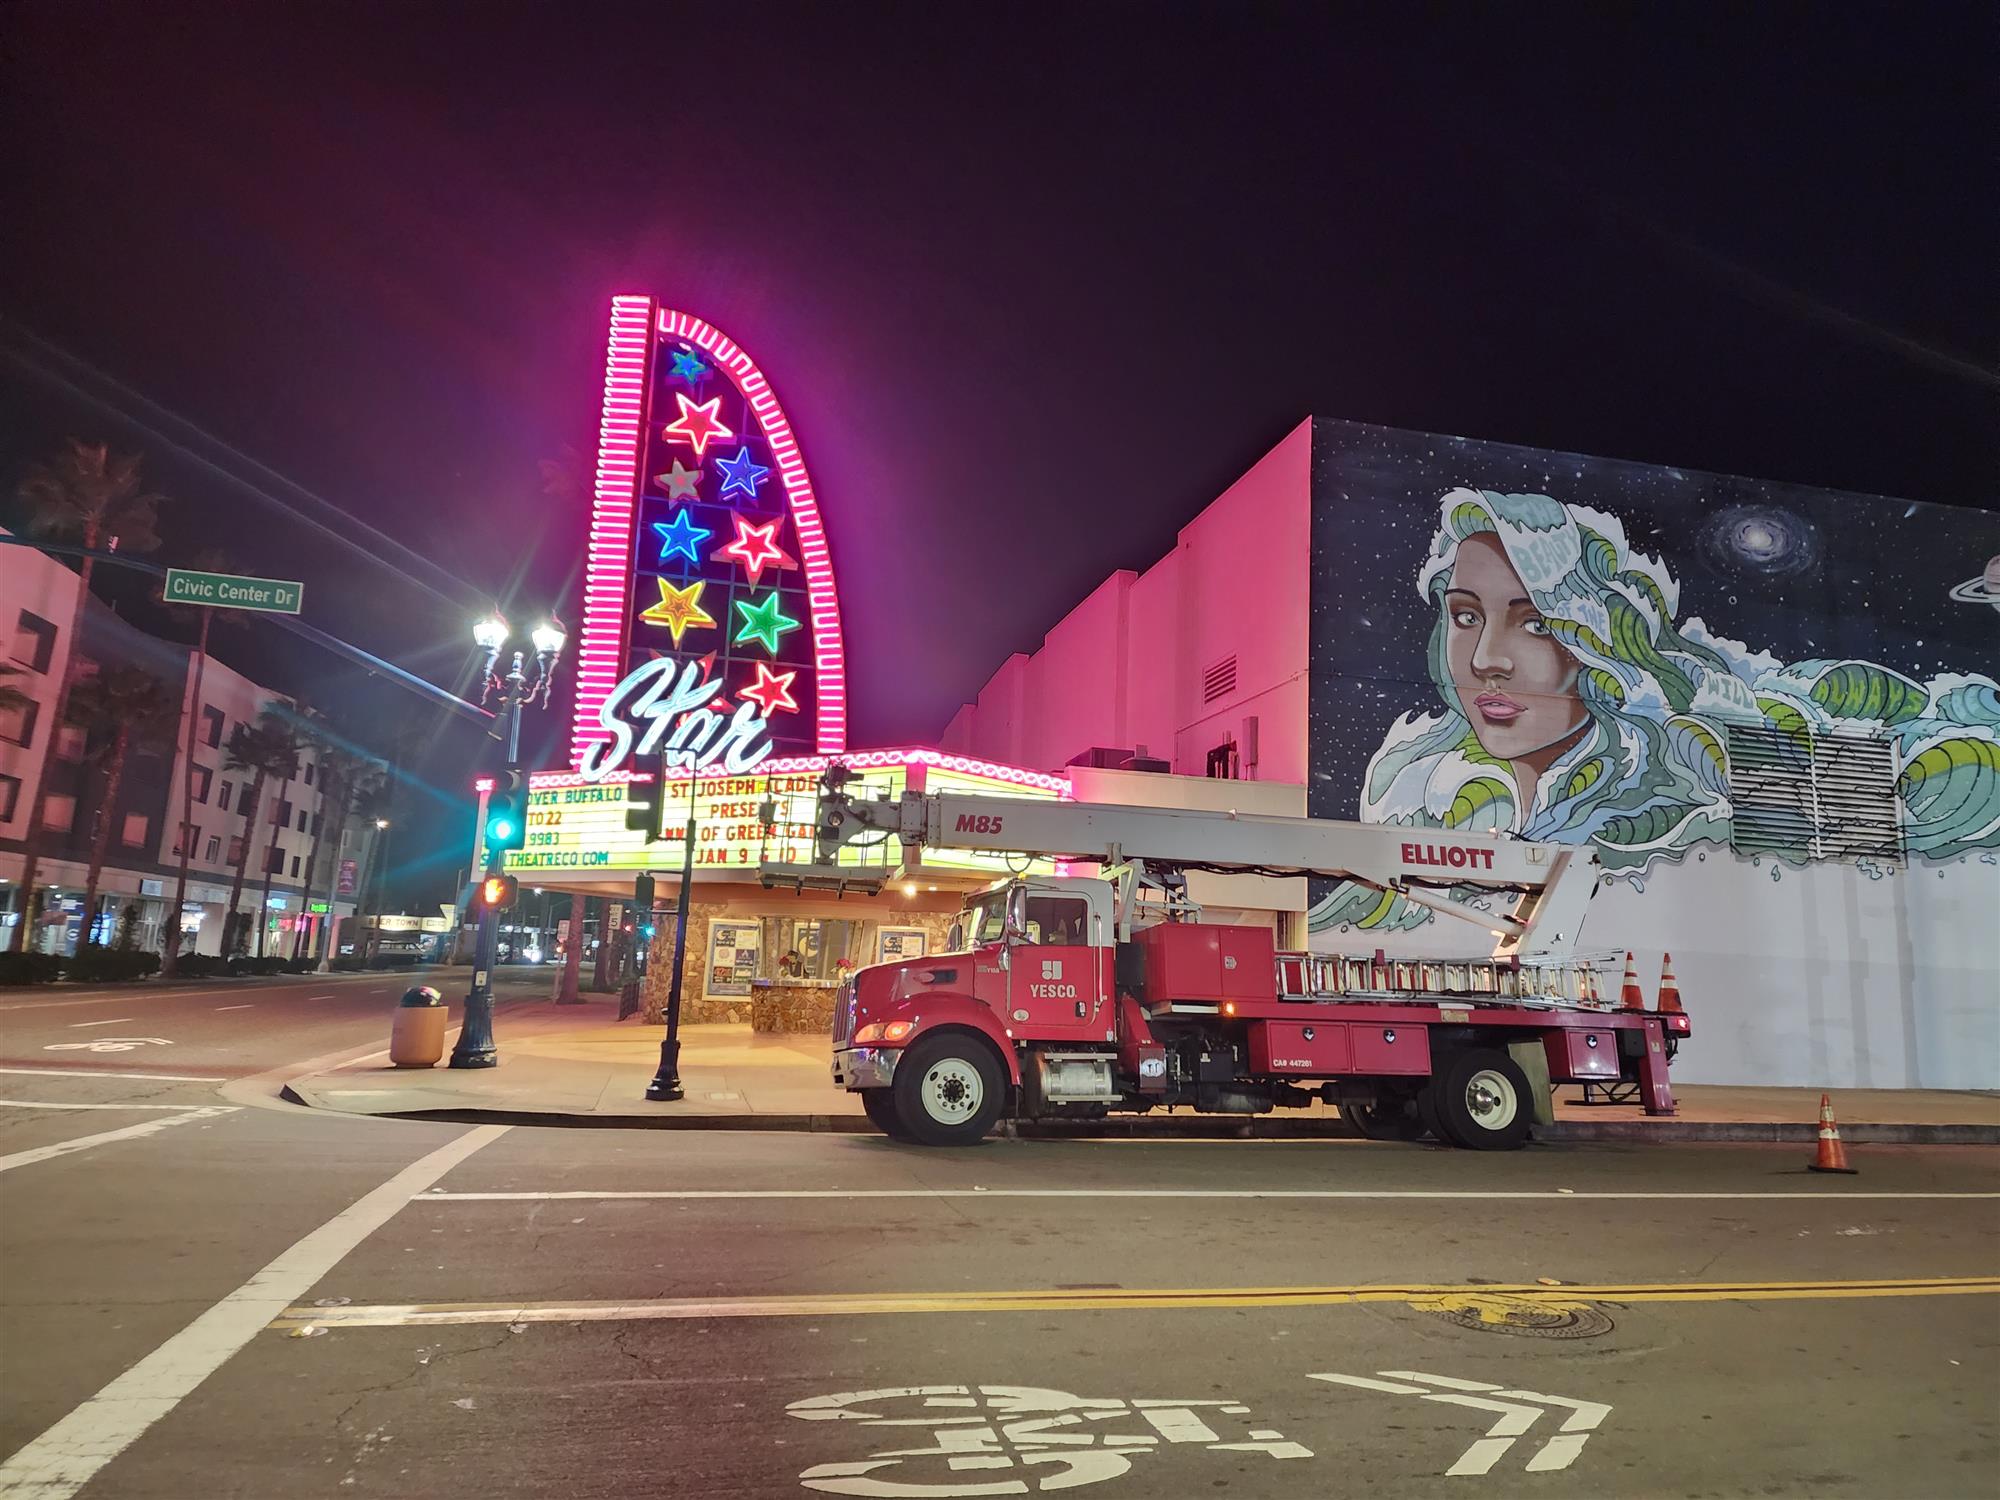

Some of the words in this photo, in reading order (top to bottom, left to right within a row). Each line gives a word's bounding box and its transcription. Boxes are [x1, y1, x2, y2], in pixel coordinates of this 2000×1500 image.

[1510, 528, 1580, 583] BEAUTY
[173, 577, 213, 597] Civic
[218, 582, 270, 603] Center
[275, 588, 294, 605] Dr
[1577, 603, 1606, 638] THE
[1706, 671, 1754, 709] WILL
[1816, 667, 1924, 715] ALWAYS
[579, 656, 773, 782] Star
[565, 787, 622, 803] BUFFALO
[671, 783, 689, 798] ST
[696, 779, 755, 797] JOSEPH
[528, 811, 544, 826] TO
[546, 811, 562, 825] 22
[710, 799, 789, 819] PRESES
[701, 826, 720, 842] OF
[955, 814, 1002, 834] M85
[529, 832, 560, 846] 9983
[583, 850, 609, 865] COM
[696, 847, 727, 864] JAN
[739, 847, 748, 864] 9
[1401, 843, 1494, 869] ELLIOTT
